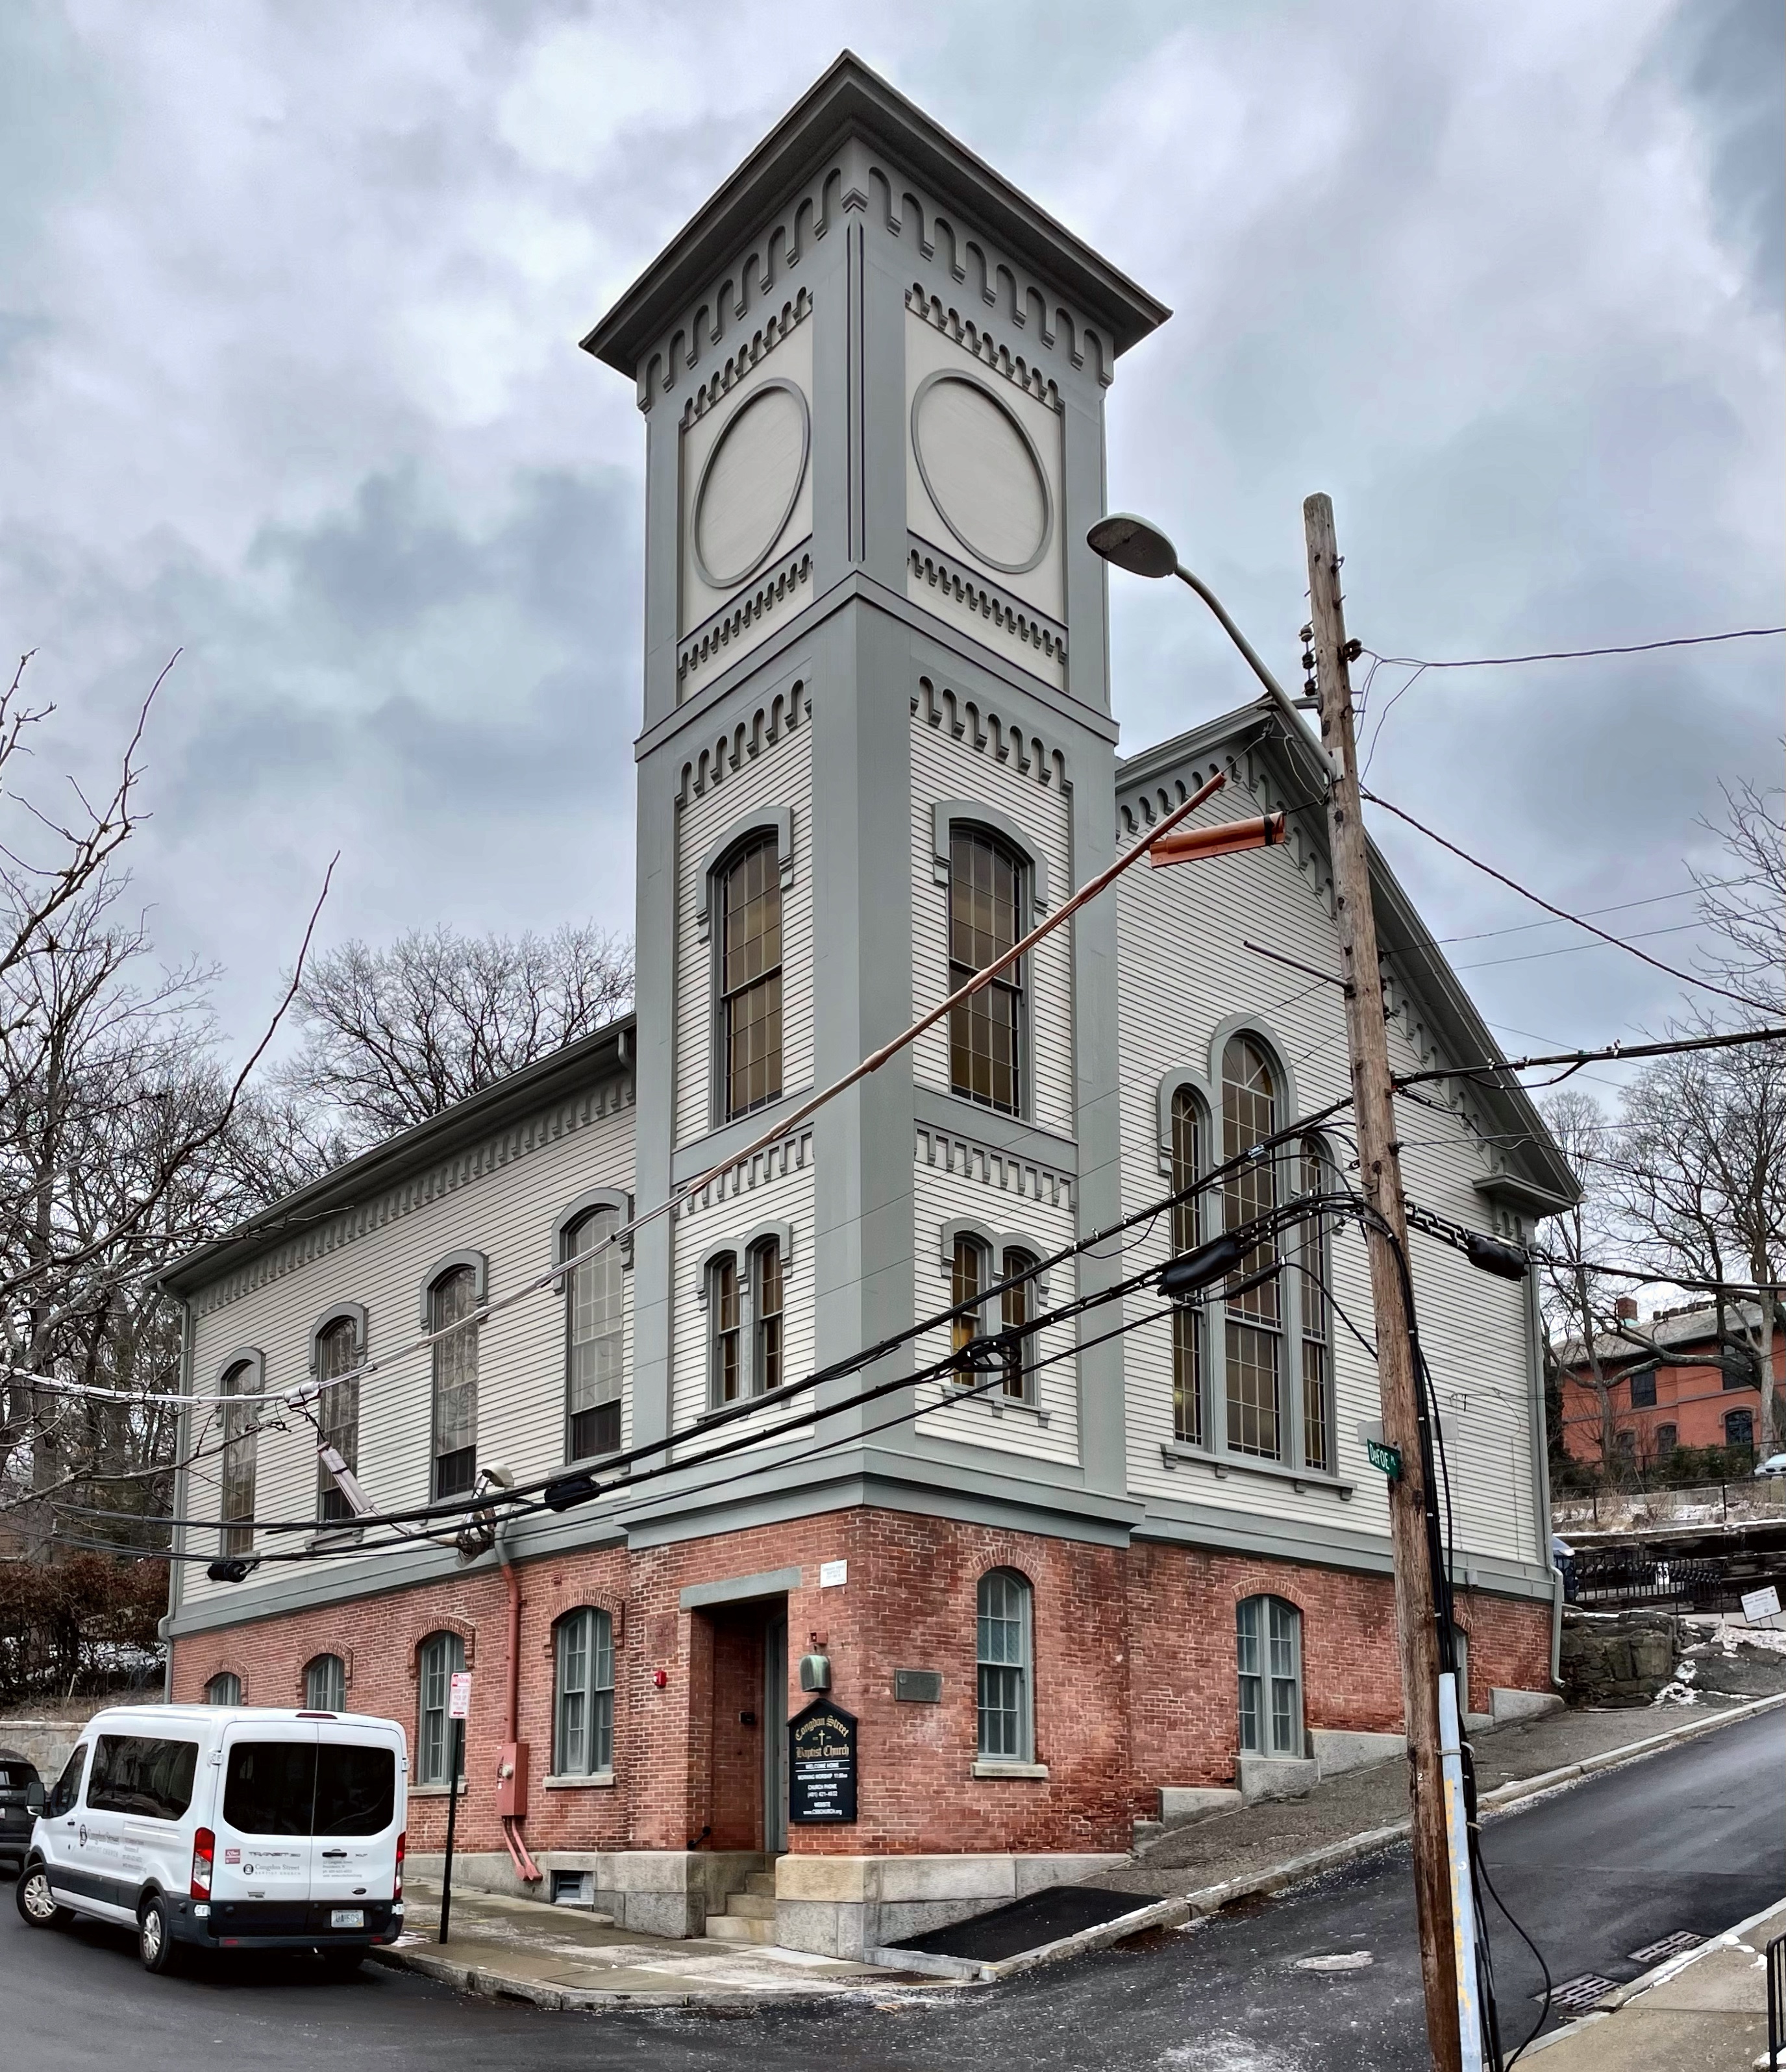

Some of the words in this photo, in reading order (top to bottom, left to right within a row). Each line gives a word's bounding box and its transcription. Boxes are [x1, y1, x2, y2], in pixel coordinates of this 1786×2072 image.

[795, 1718, 825, 1741] Congdon
[826, 1715, 849, 1737] Street
[796, 1746, 822, 1760] Baptist
[823, 1744, 849, 1758] Church
[1417, 1773, 1423, 1781] 2
